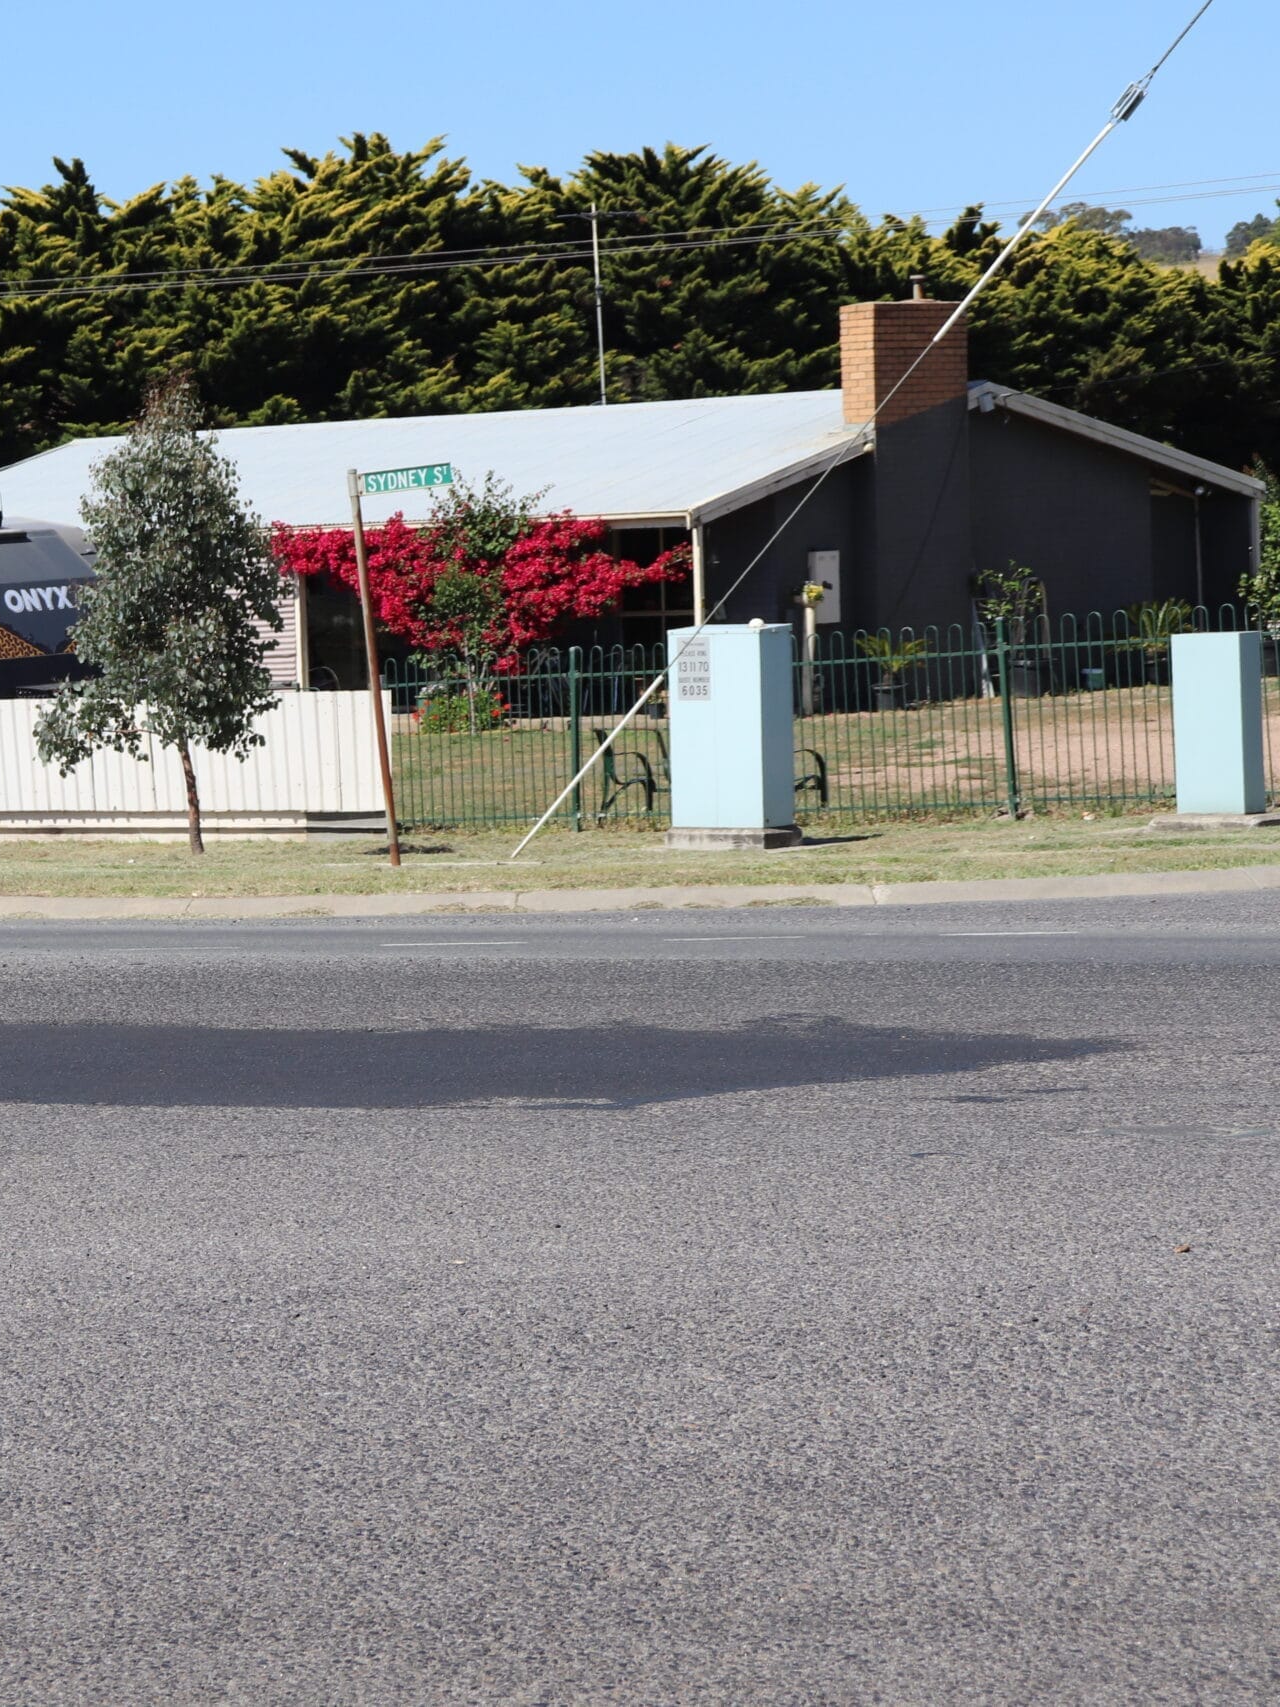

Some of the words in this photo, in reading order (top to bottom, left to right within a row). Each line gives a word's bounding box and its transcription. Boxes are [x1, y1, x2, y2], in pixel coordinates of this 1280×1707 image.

[367, 467, 428, 492] SYDNEY
[433, 465, 449, 484] ST
[4, 585, 74, 613] ONYX
[681, 685, 708, 696] 6035
